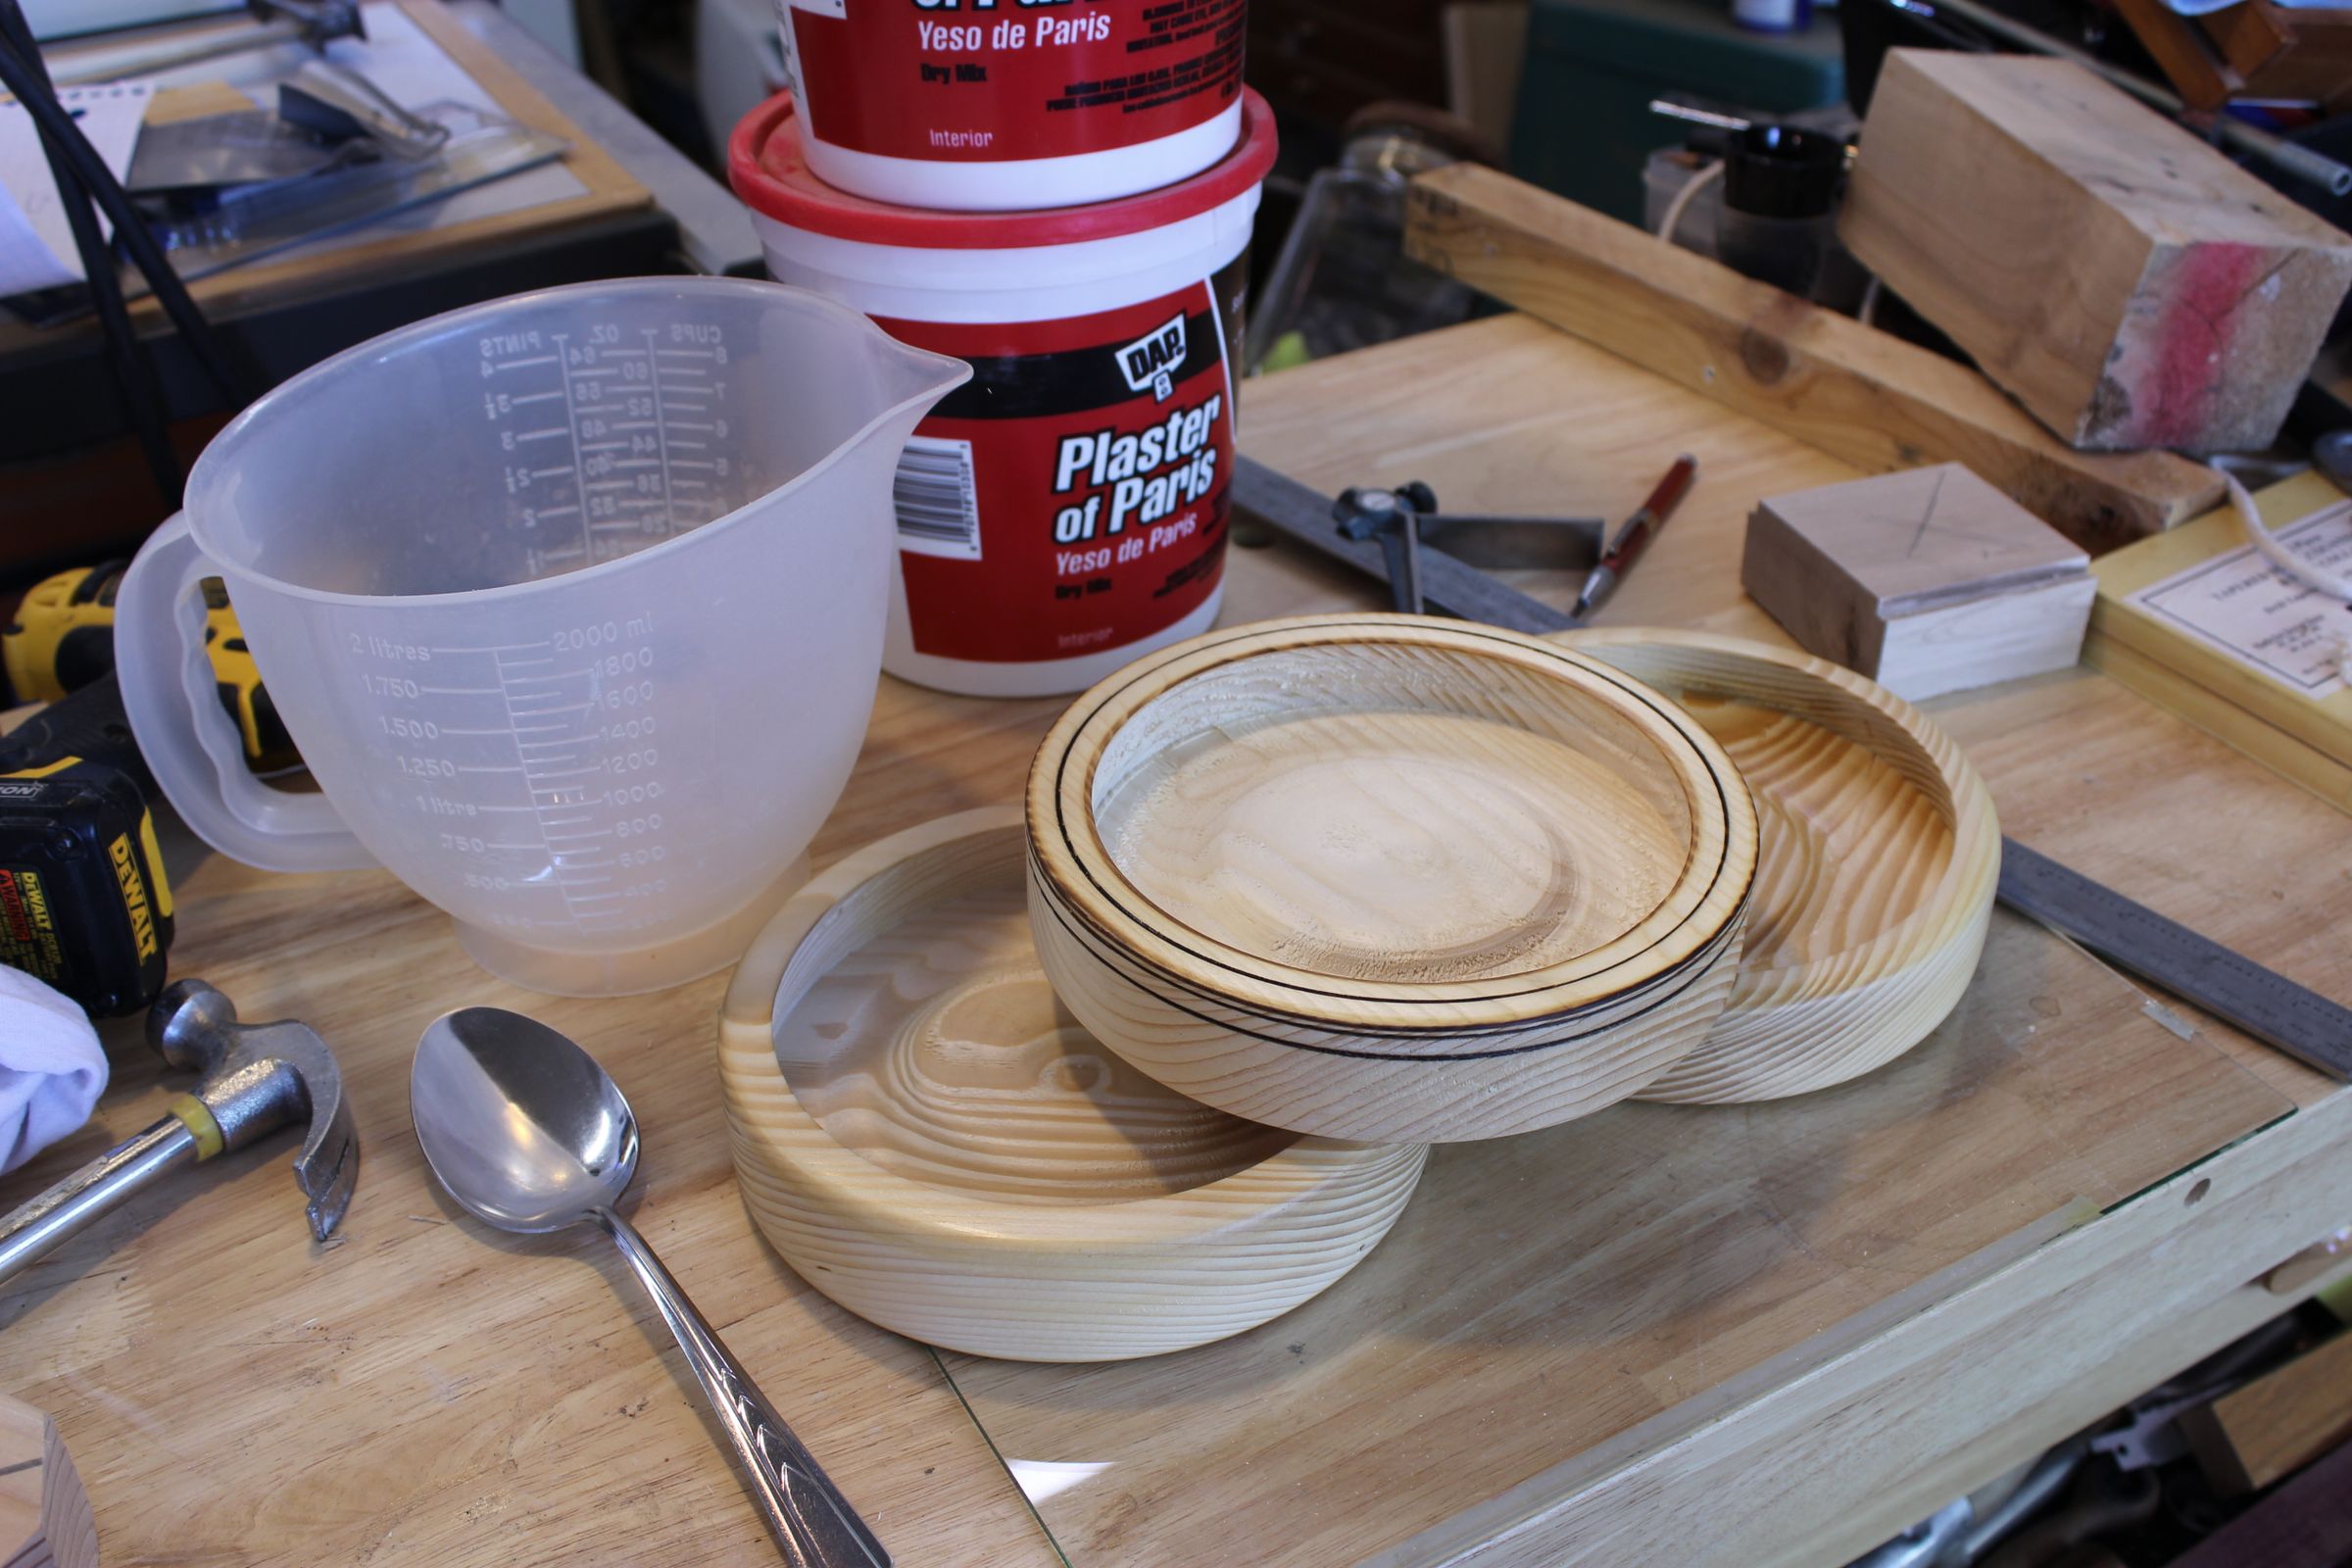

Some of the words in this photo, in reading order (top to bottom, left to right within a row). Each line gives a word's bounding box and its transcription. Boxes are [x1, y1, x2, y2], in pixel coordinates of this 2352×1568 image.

[918, 21, 982, 51] Yeso
[992, 20, 1026, 49] de
[1036, 12, 1110, 47] Paris
[920, 63, 951, 84] Dry
[930, 128, 993, 147] Interior
[1054, 394, 1221, 492] Plaster
[1054, 496, 1102, 543] of
[1109, 449, 1217, 533] Paris
[1056, 548, 1111, 575] Yeso
[1118, 537, 1144, 564] de
[1150, 513, 1197, 553] Paris
[555, 621, 617, 652] 2000
[627, 612, 654, 636] ml
[368, 636, 431, 662] litres
[594, 647, 654, 677] 1800
[362, 673, 419, 699] 1.750
[596, 681, 655, 711] 1600
[379, 715, 439, 740] 1.500
[600, 716, 657, 744] 1400
[396, 755, 456, 777] 1.250
[602, 749, 659, 775] 1200
[604, 782, 662, 808] 1000
[615, 813, 663, 838] 800
[22, 872, 52, 930] DEWALT
[109, 833, 158, 966] DEWALT
